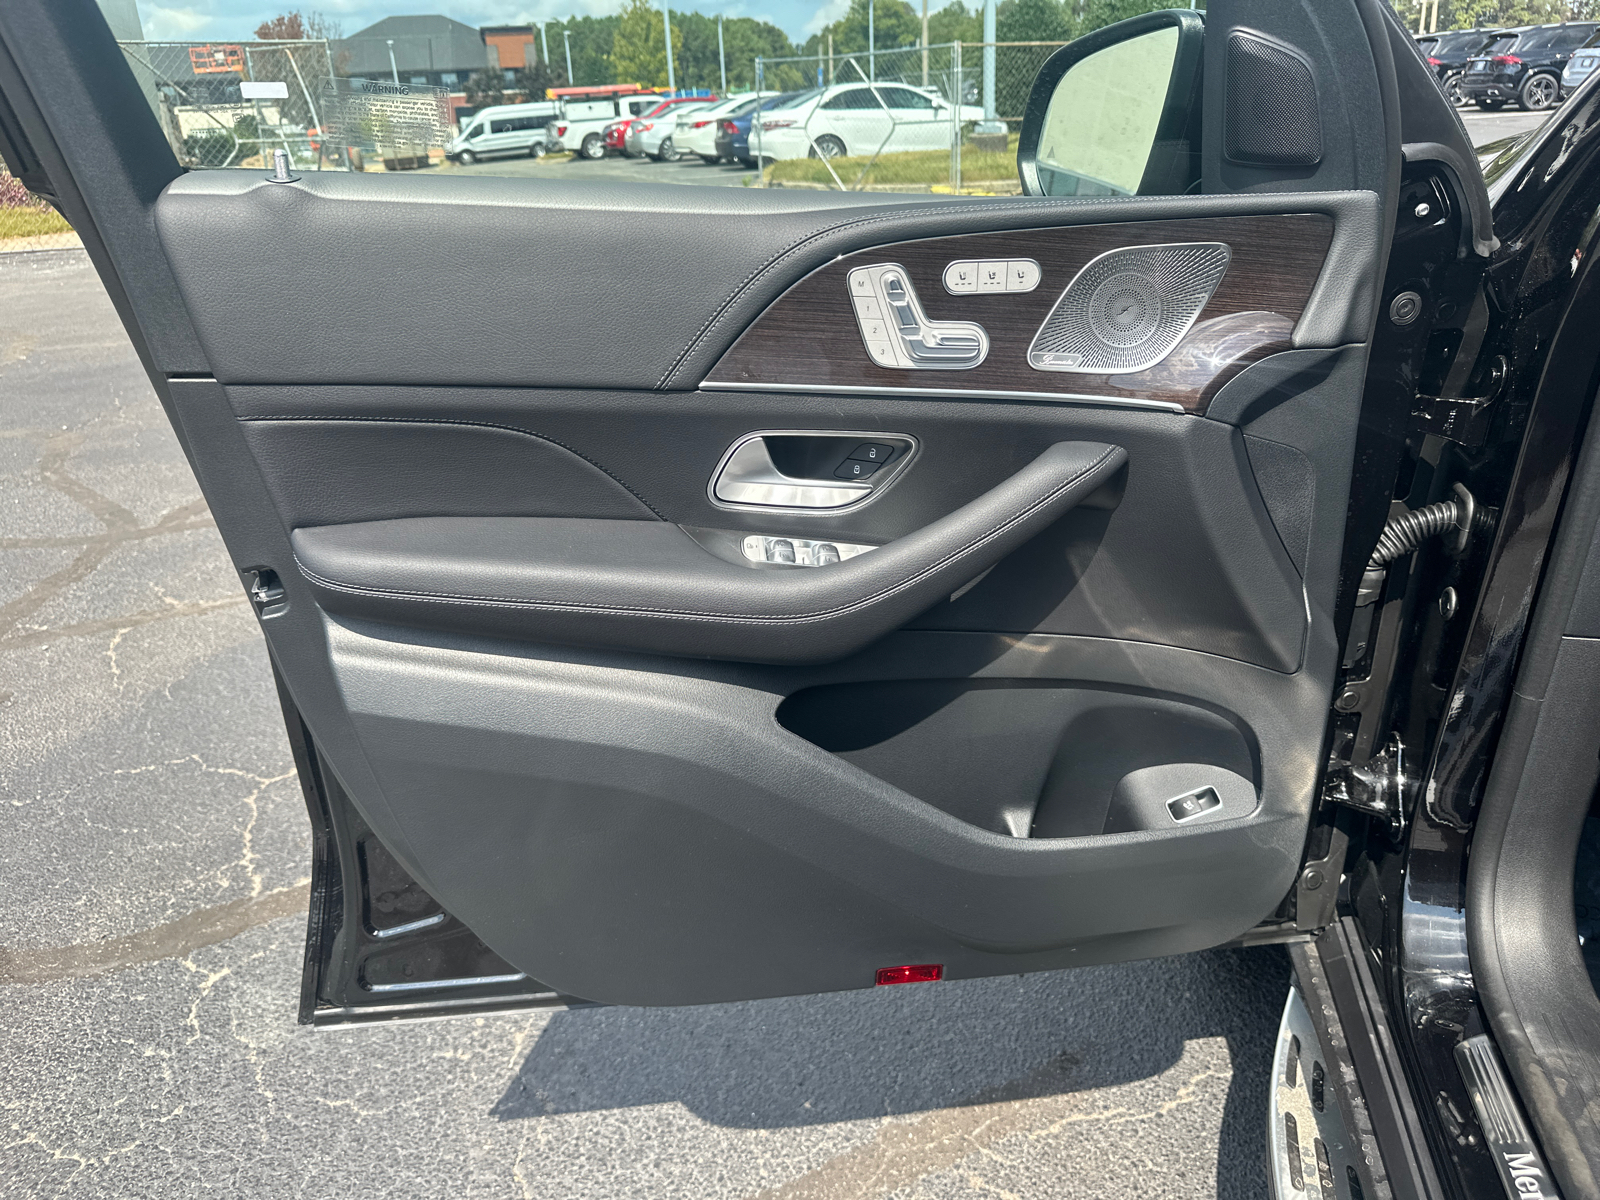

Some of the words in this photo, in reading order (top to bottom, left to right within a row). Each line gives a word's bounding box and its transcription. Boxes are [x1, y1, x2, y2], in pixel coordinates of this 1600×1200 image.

[362, 83, 409, 95] WARNING
[857, 280, 865, 288] M
[880, 348, 886, 356] 3
